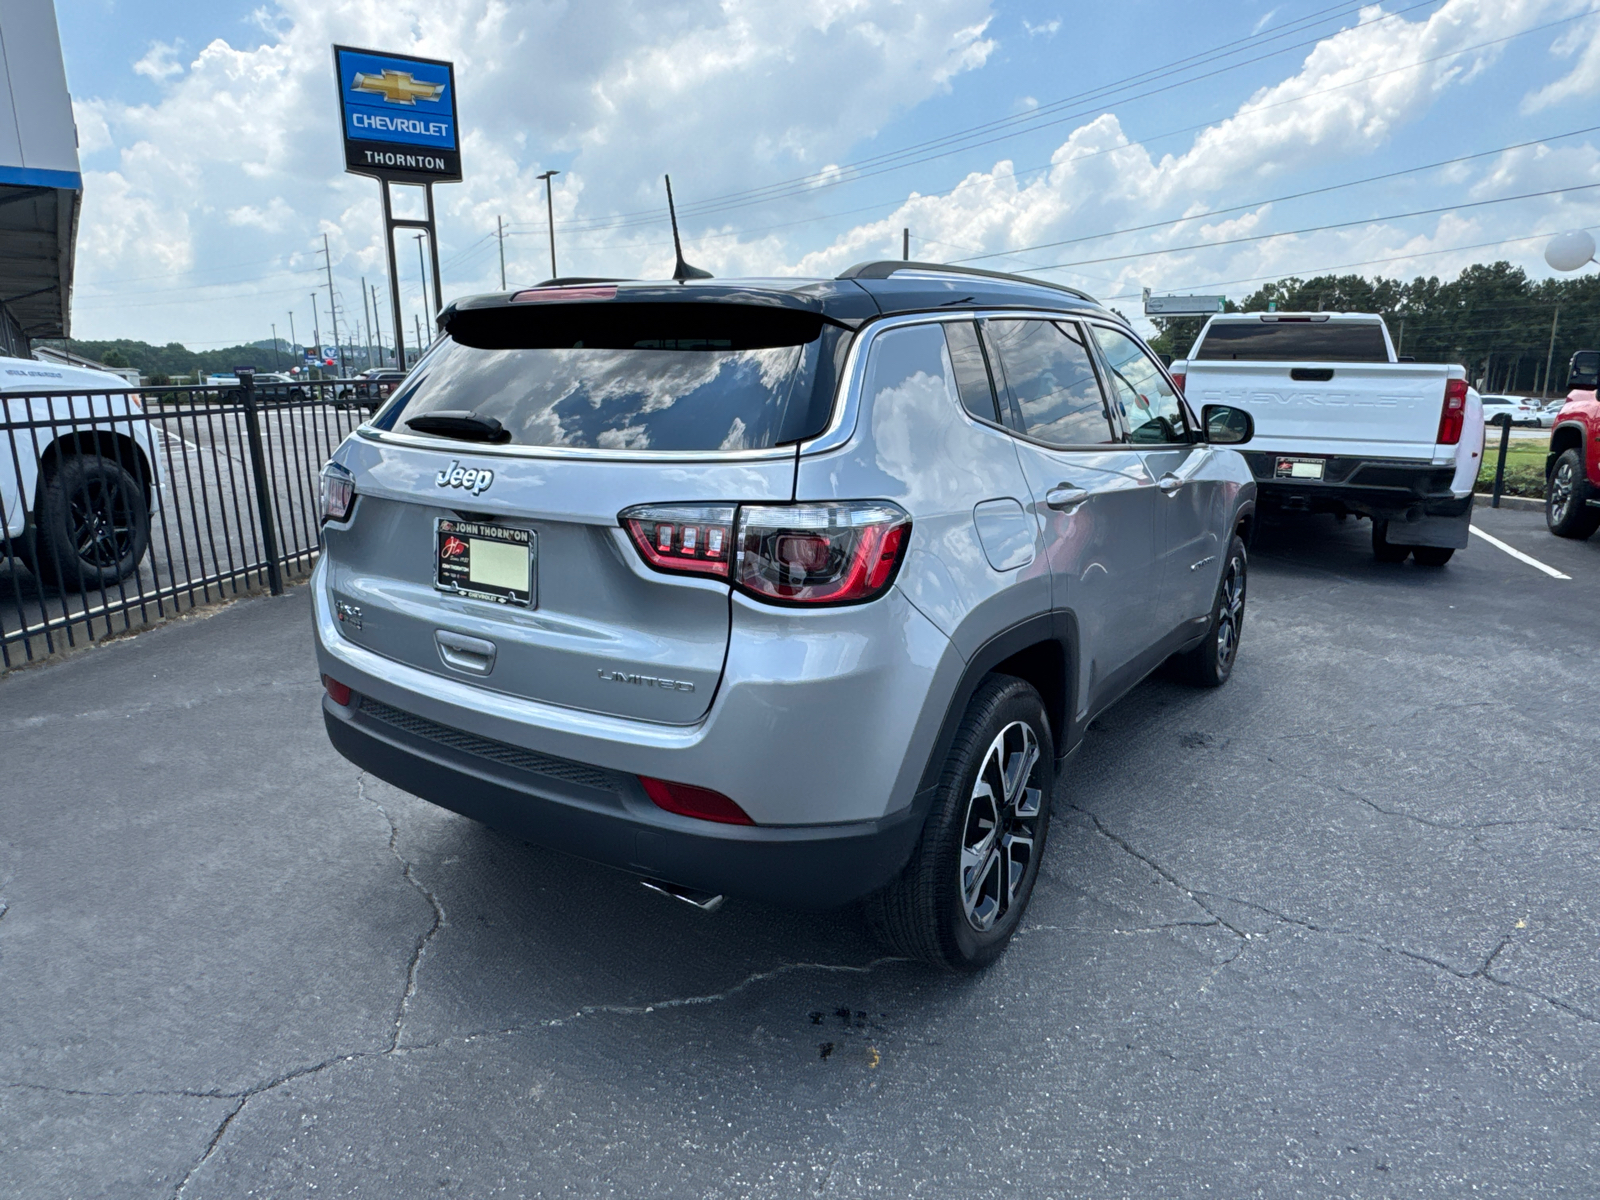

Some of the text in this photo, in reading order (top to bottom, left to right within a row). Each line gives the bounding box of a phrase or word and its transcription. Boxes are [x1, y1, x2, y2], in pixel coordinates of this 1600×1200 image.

[352, 113, 449, 137] CHEVROLET
[364, 150, 446, 170] THORNTON
[1200, 390, 1425, 409] CHEVROLET
[435, 459, 495, 497] Jeep
[456, 522, 528, 542] JOHN THORNTON
[468, 592, 497, 602] CHEVROLET
[597, 668, 695, 692] LIMITED
